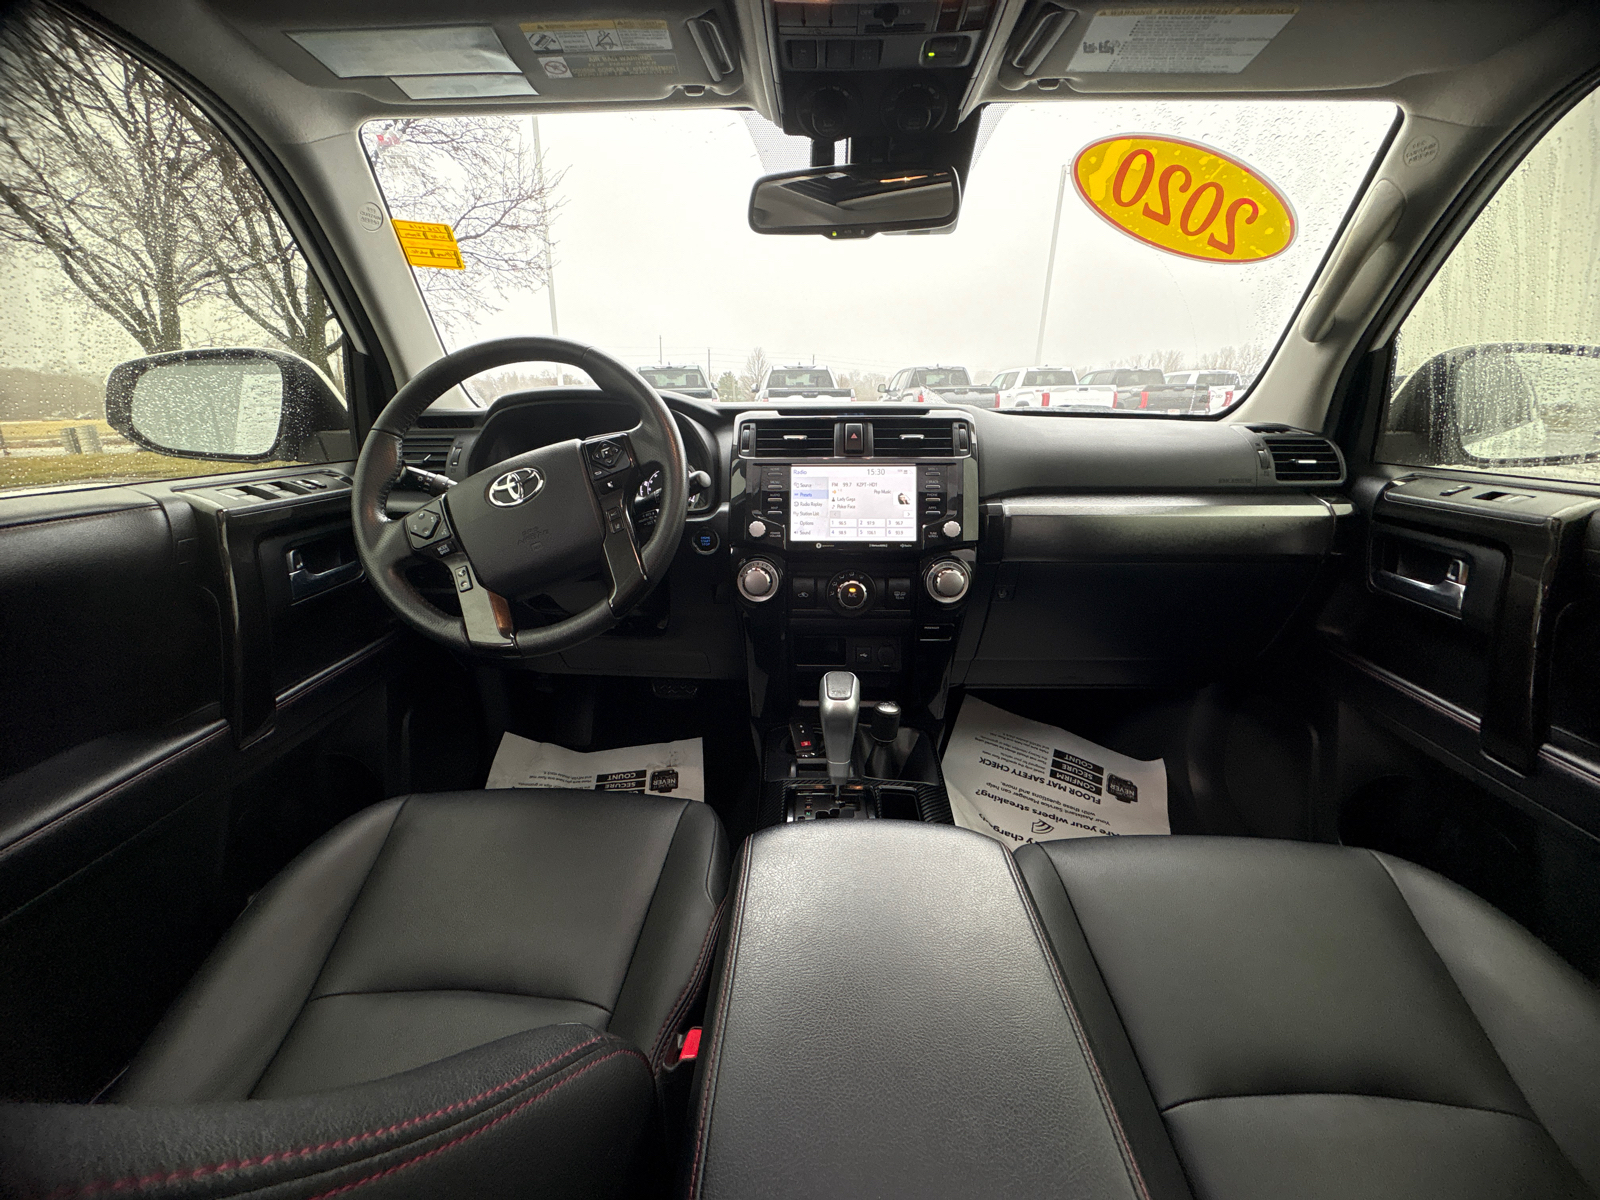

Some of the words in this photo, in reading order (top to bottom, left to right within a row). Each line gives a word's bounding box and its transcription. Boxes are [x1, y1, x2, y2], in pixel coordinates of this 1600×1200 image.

[979, 756, 1010, 772] CHECK
[1065, 754, 1093, 769] COUNT
[1011, 769, 1045, 784] SAFETY
[1061, 764, 1093, 780] SECURE
[986, 781, 1000, 790] help
[1000, 781, 1018, 791] more.
[1046, 780, 1067, 792] MAT
[1056, 772, 1096, 792] CONFIRM
[1069, 787, 1101, 805] FLOOR
[1110, 784, 1135, 796] NEVER
[975, 788, 1030, 812] streaking?
[1013, 791, 1040, 805] Manager
[1032, 792, 1062, 806] questions
[1041, 801, 1063, 812] Service
[1063, 803, 1081, 812] these
[1082, 808, 1096, 816] with
[1032, 808, 1068, 825] wipers
[1064, 808, 1095, 821] Assistant
[1070, 821, 1098, 834] your
[1095, 817, 1110, 826] Your
